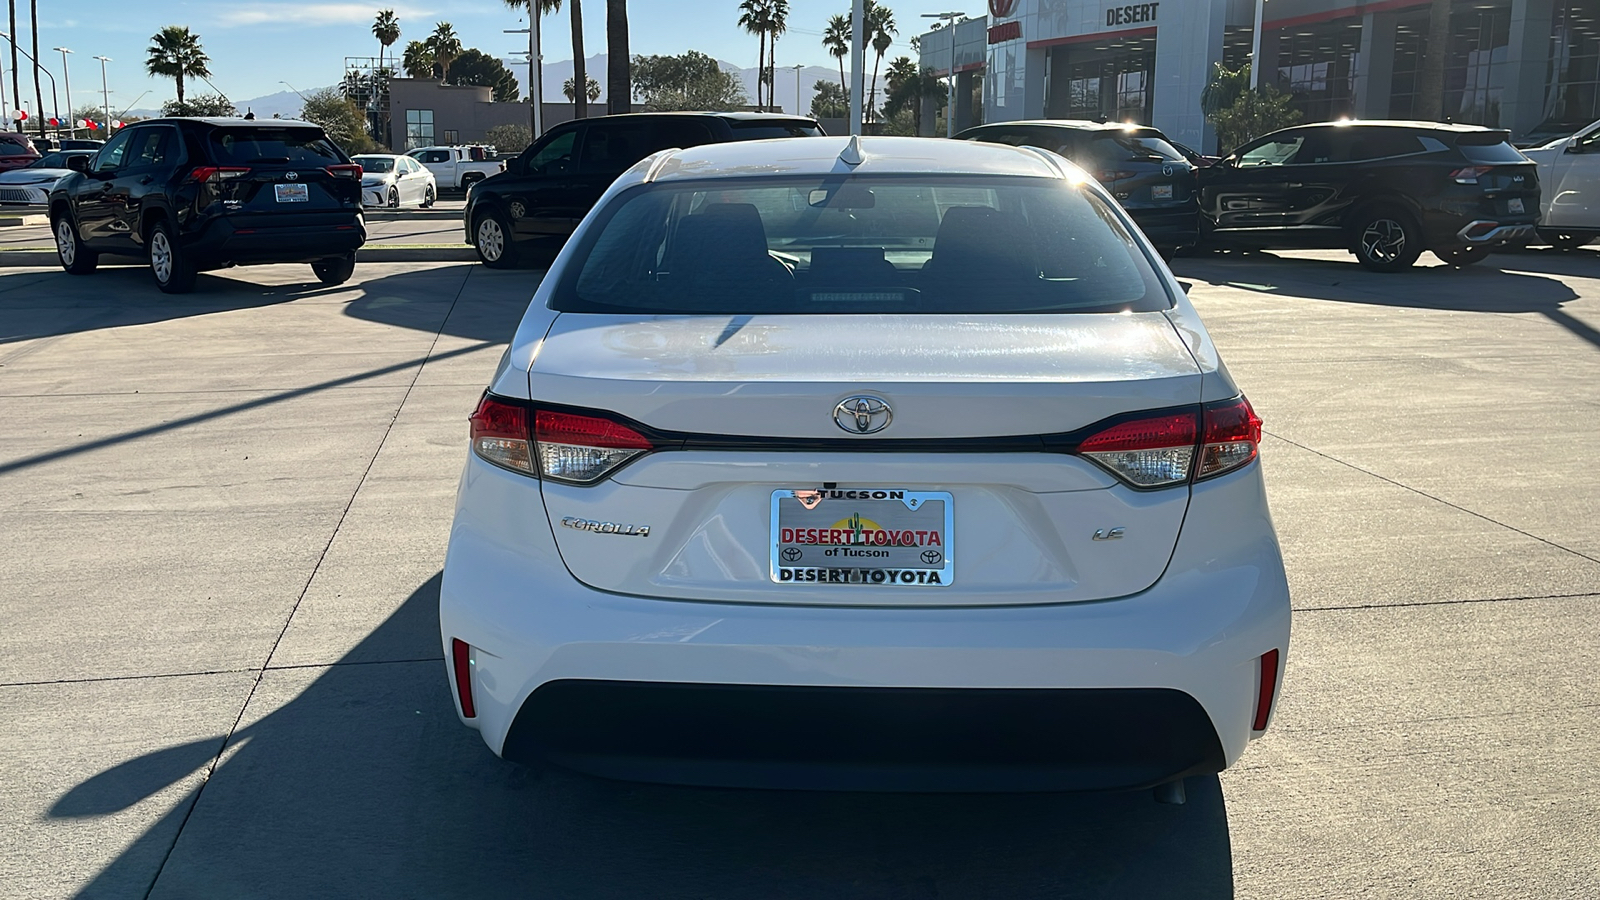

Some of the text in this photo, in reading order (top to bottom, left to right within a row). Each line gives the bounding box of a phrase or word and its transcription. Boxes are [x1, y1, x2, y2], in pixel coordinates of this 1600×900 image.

[1106, 2, 1159, 26] DESERT
[818, 490, 904, 500] TUCSON
[561, 516, 651, 537] COROLLA
[1092, 526, 1126, 541] LE
[781, 528, 942, 546] DESERT TOYOTA
[824, 547, 890, 558] of Tucson
[779, 568, 942, 584] DESERT TOYOTA
